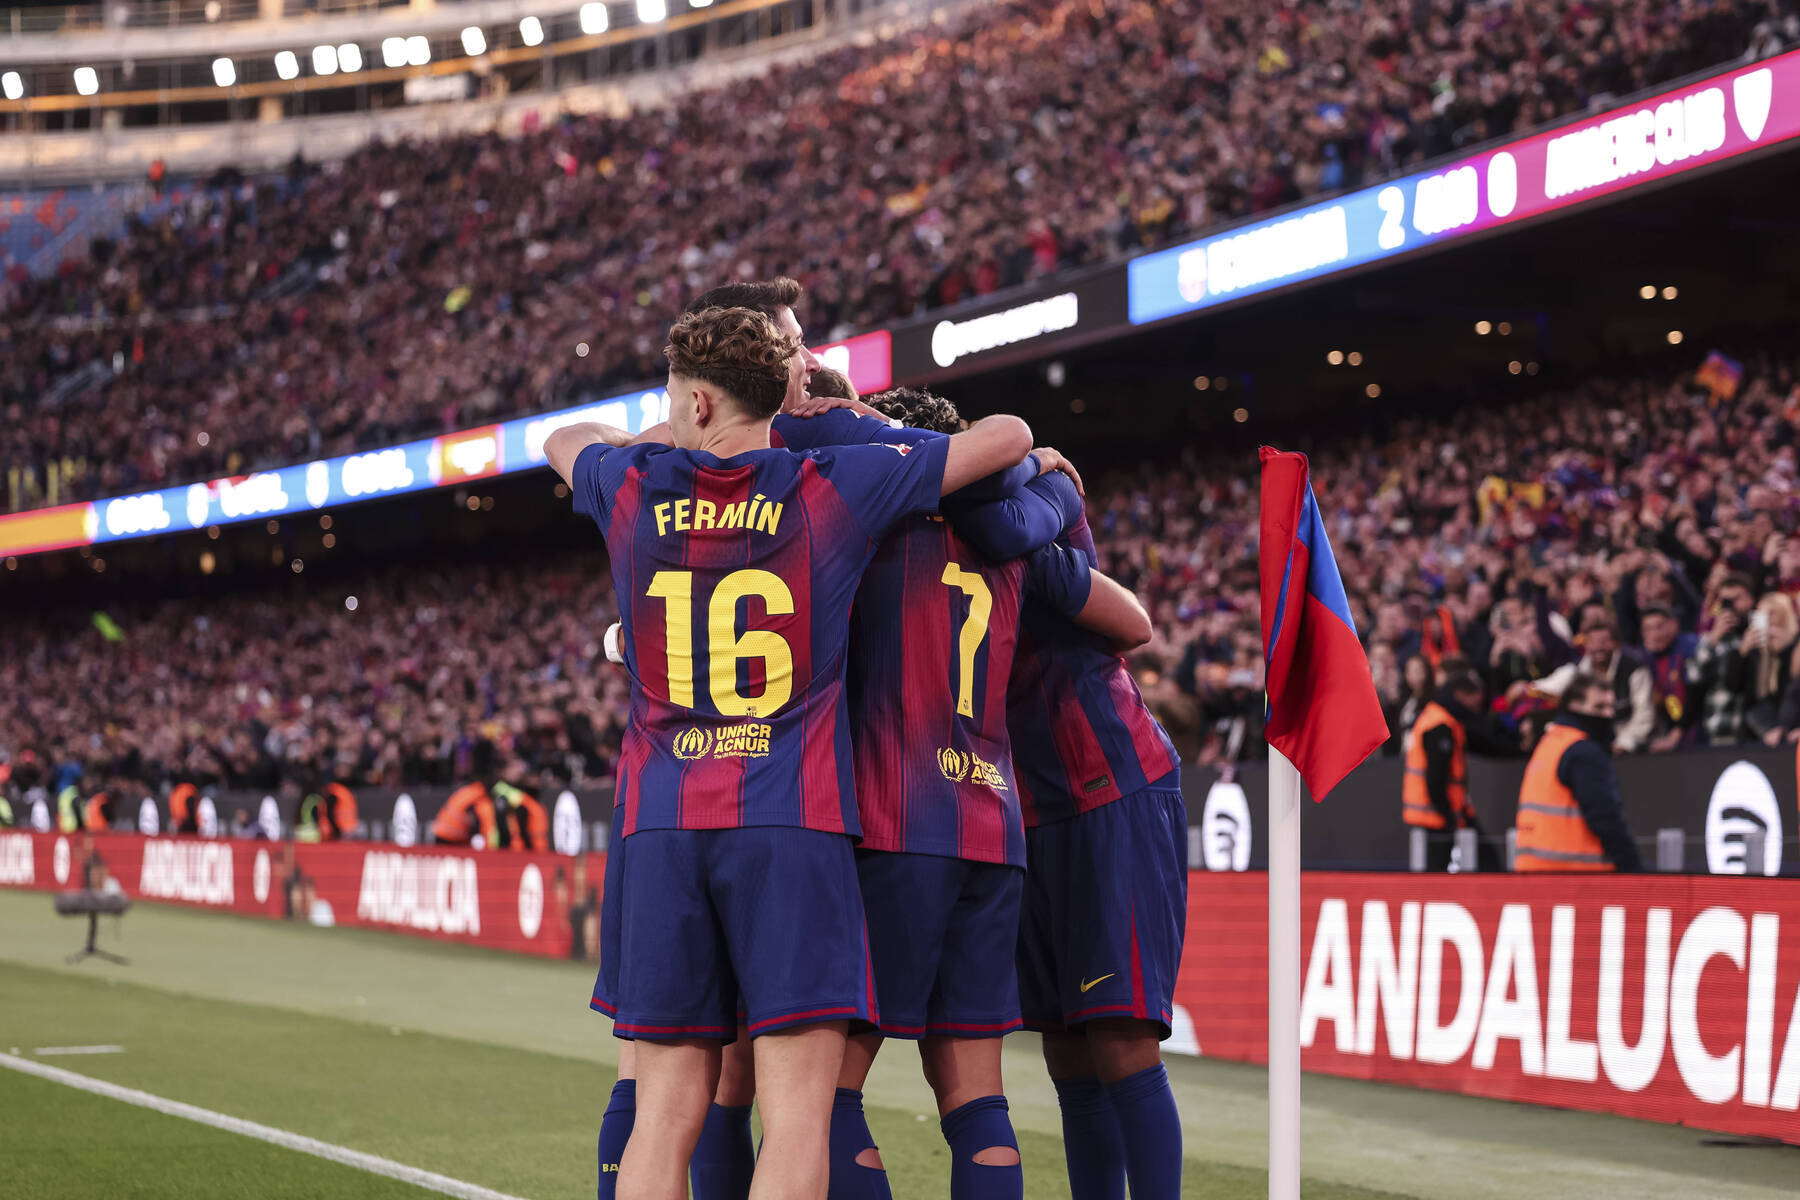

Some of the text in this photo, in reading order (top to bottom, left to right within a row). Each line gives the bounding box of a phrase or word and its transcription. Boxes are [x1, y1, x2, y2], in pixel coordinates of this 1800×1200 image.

[1378, 186, 1405, 250] 2
[653, 493, 784, 537] FERMÍN
[646, 569, 795, 718] 16
[713, 736, 769, 754] ACNUR
[716, 723, 772, 741] UNHCR
